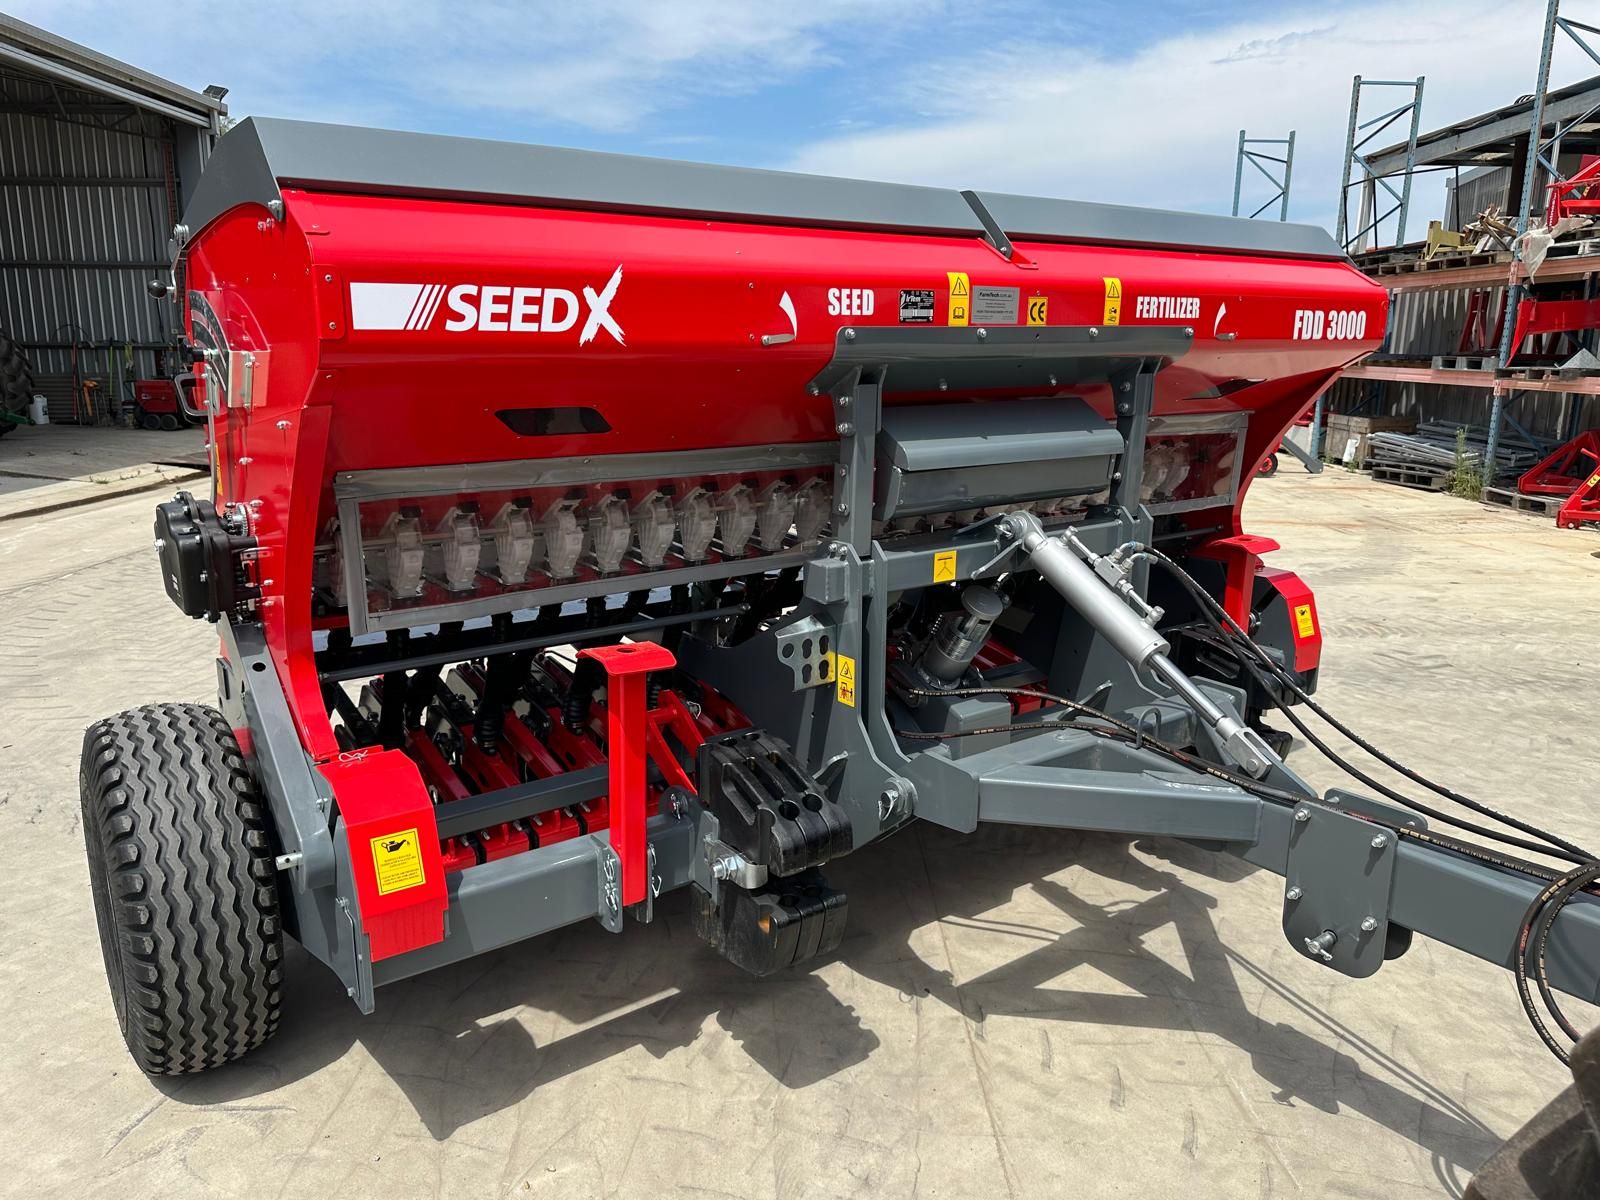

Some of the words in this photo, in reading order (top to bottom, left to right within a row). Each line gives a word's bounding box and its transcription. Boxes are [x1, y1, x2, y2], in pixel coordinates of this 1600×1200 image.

[828, 288, 875, 316] SEED
[1135, 296, 1200, 318] FERTILIZER
[1293, 310, 1325, 340] FDD
[1326, 310, 1367, 340] 3000
